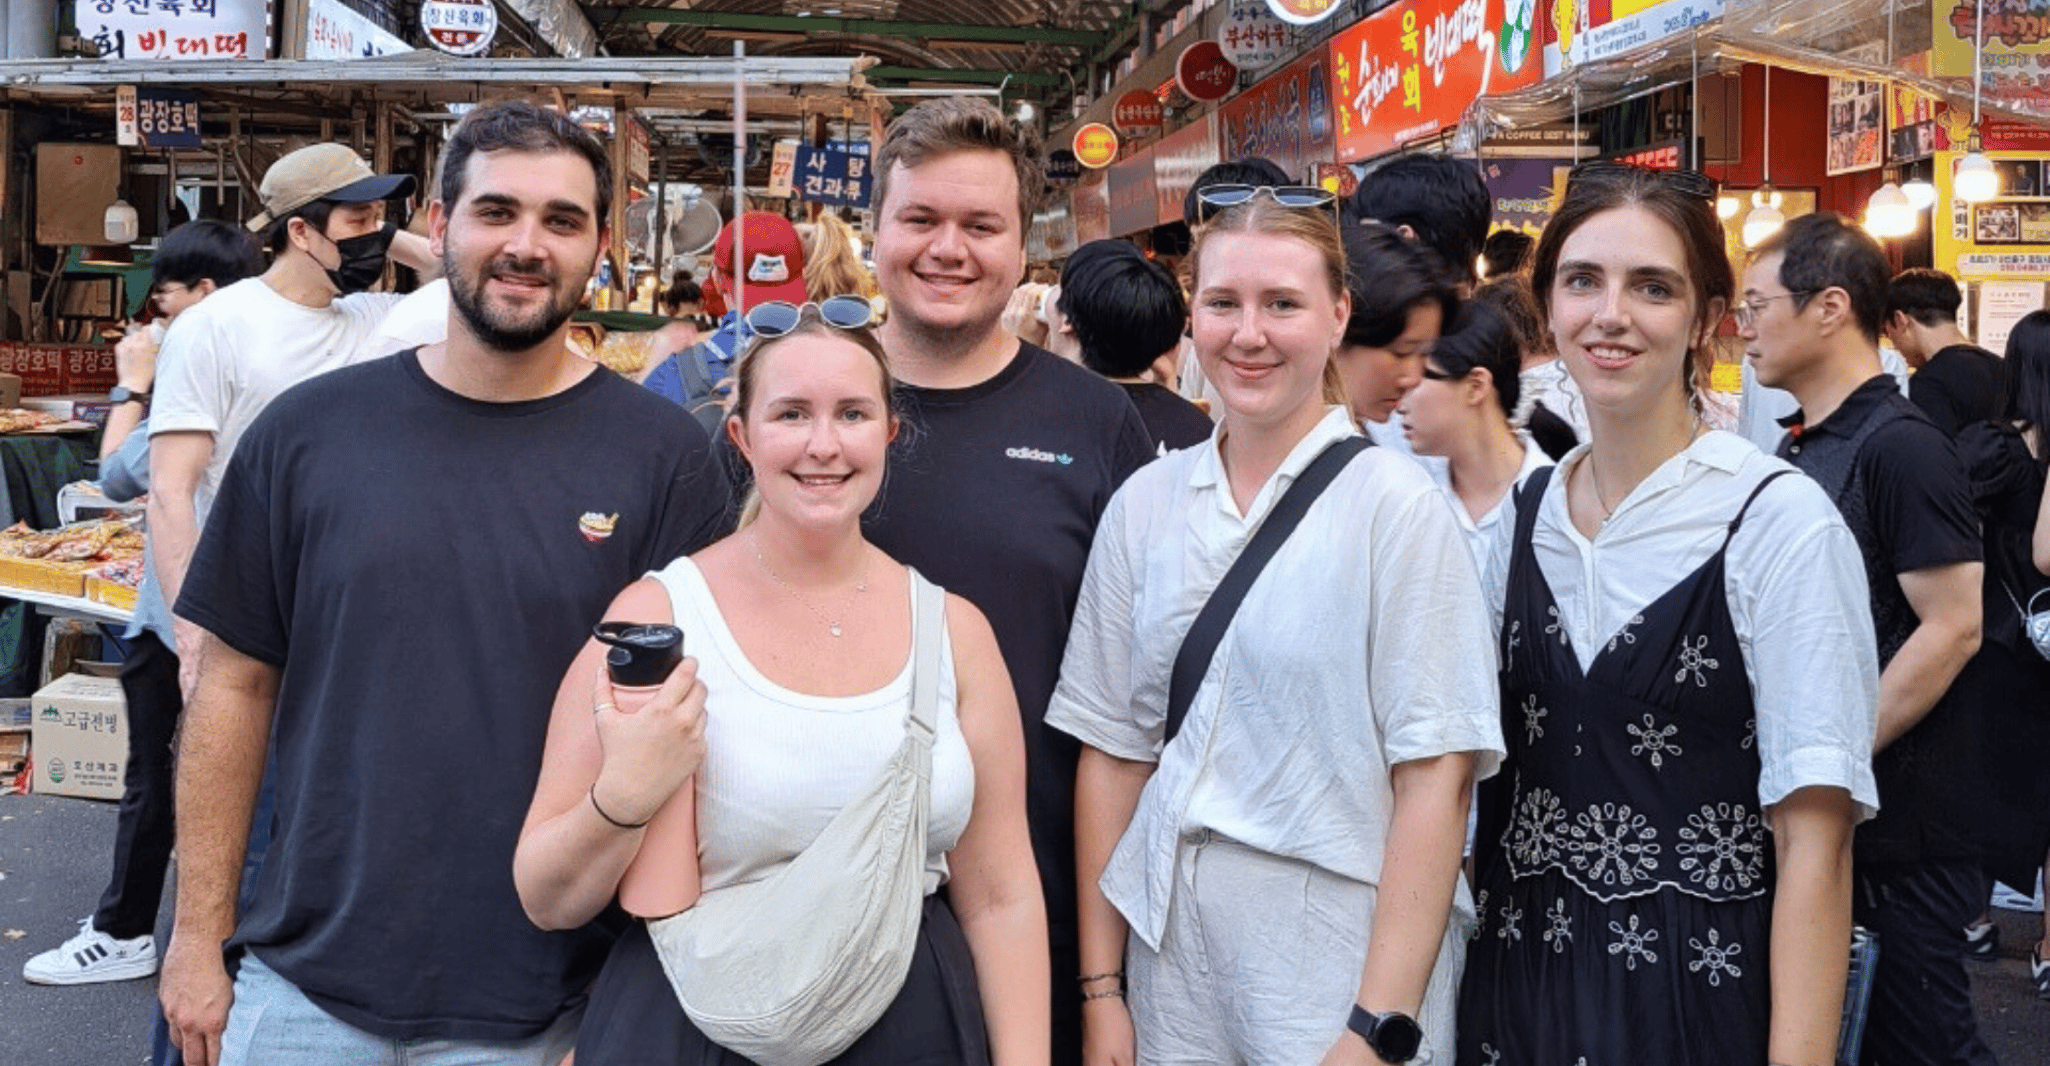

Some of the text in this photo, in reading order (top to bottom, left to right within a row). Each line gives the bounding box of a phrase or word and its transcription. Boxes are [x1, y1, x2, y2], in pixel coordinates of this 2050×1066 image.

[120, 106, 134, 122] 28
[140, 99, 198, 135] 광장호떡
[1613, 146, 1678, 168] FFEE
[773, 162, 791, 176] 27
[0, 346, 115, 374] 광장호떡 광장호
[1005, 446, 1055, 463] adidas
